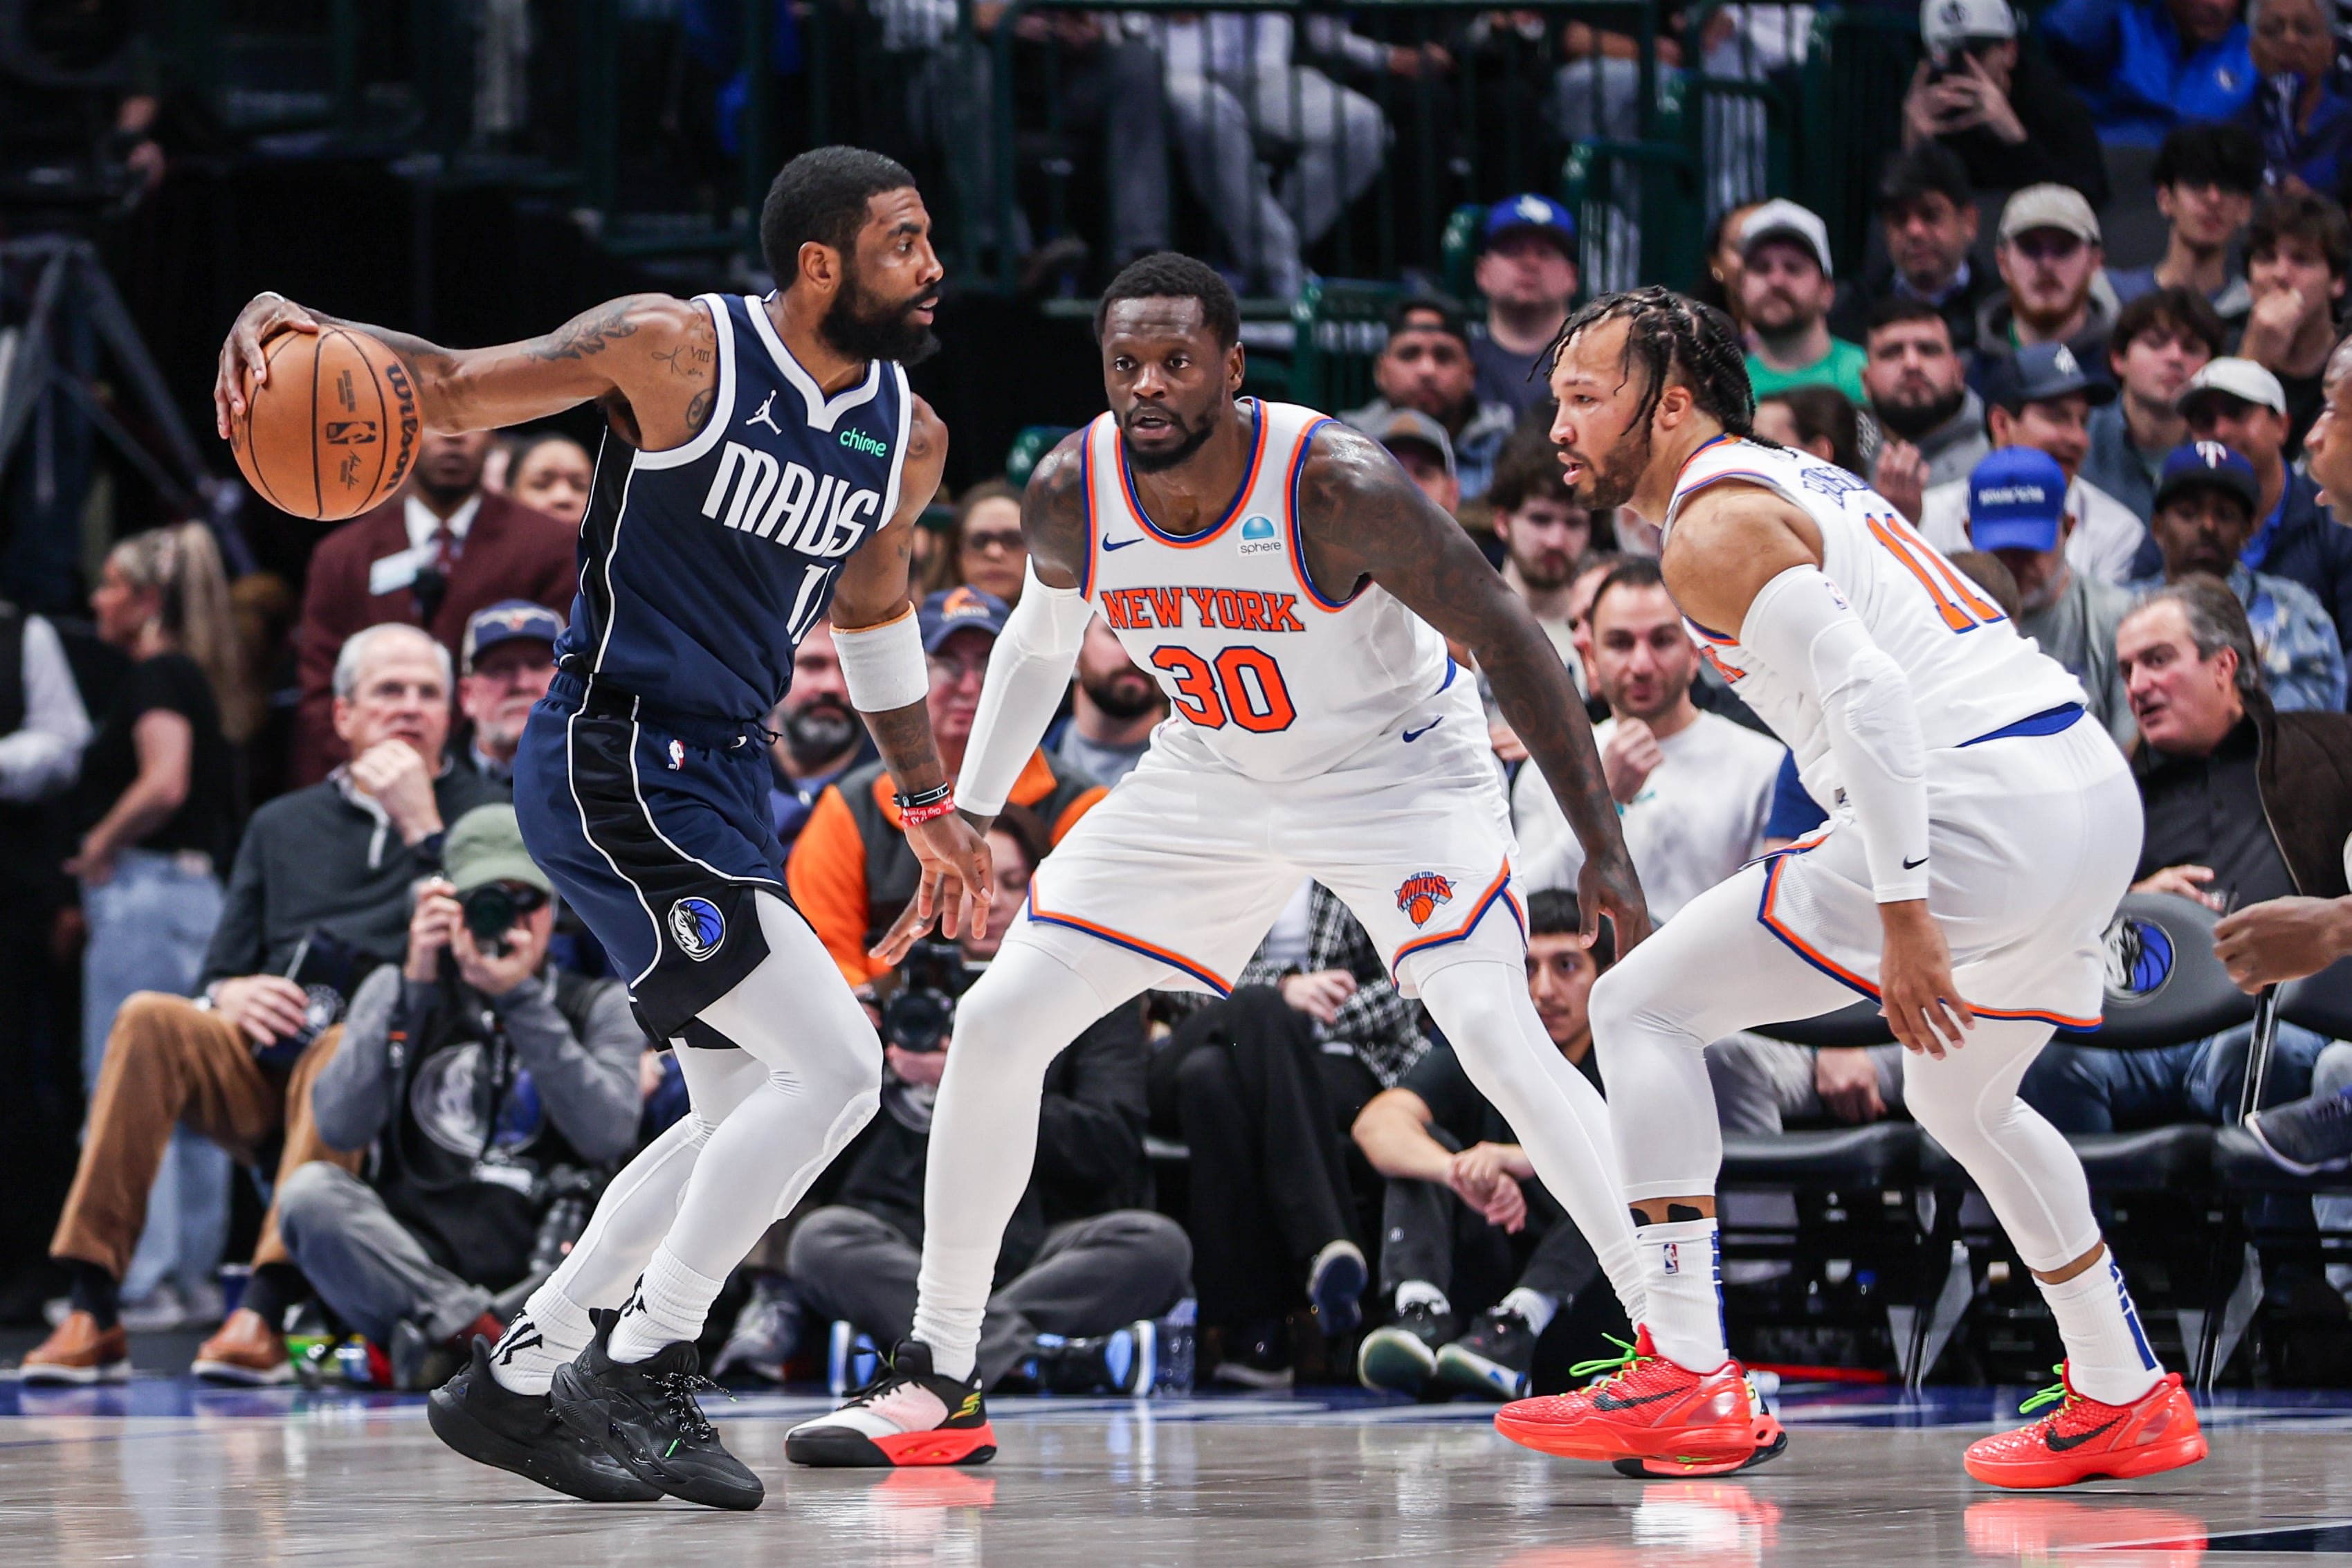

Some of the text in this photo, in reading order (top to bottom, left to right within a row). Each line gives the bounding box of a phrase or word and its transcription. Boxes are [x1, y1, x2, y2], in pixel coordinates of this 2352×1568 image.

[839, 427, 887, 457] chime
[1239, 540, 1282, 554] sphere
[1866, 513, 2009, 635] 11
[1100, 586, 1306, 632] NEW YORK
[1149, 644, 1297, 734] 30
[1397, 875, 1453, 909] KNICKS
